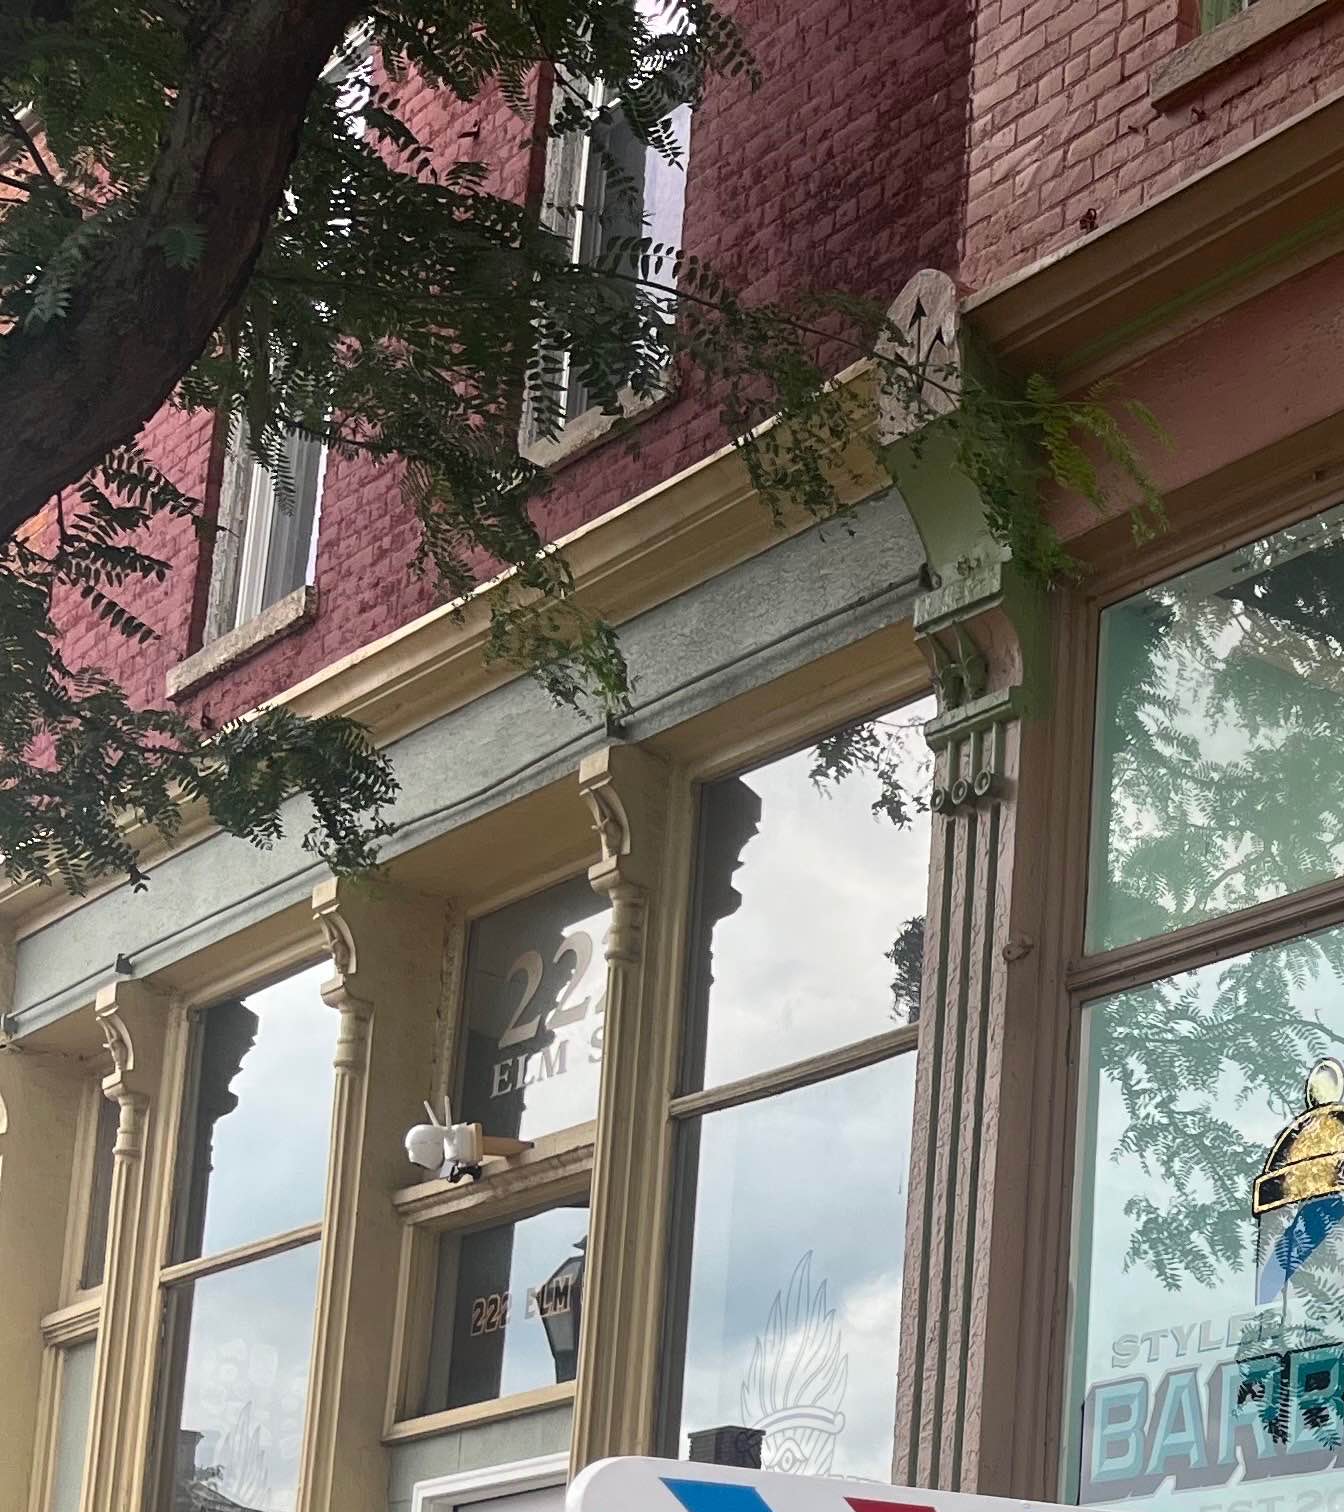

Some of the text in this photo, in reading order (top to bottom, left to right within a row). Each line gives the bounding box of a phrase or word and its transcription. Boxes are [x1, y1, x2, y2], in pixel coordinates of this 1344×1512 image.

[498, 925, 614, 1048] 22
[490, 1039, 569, 1098] ELM
[470, 1274, 573, 1337] 222 ELM
